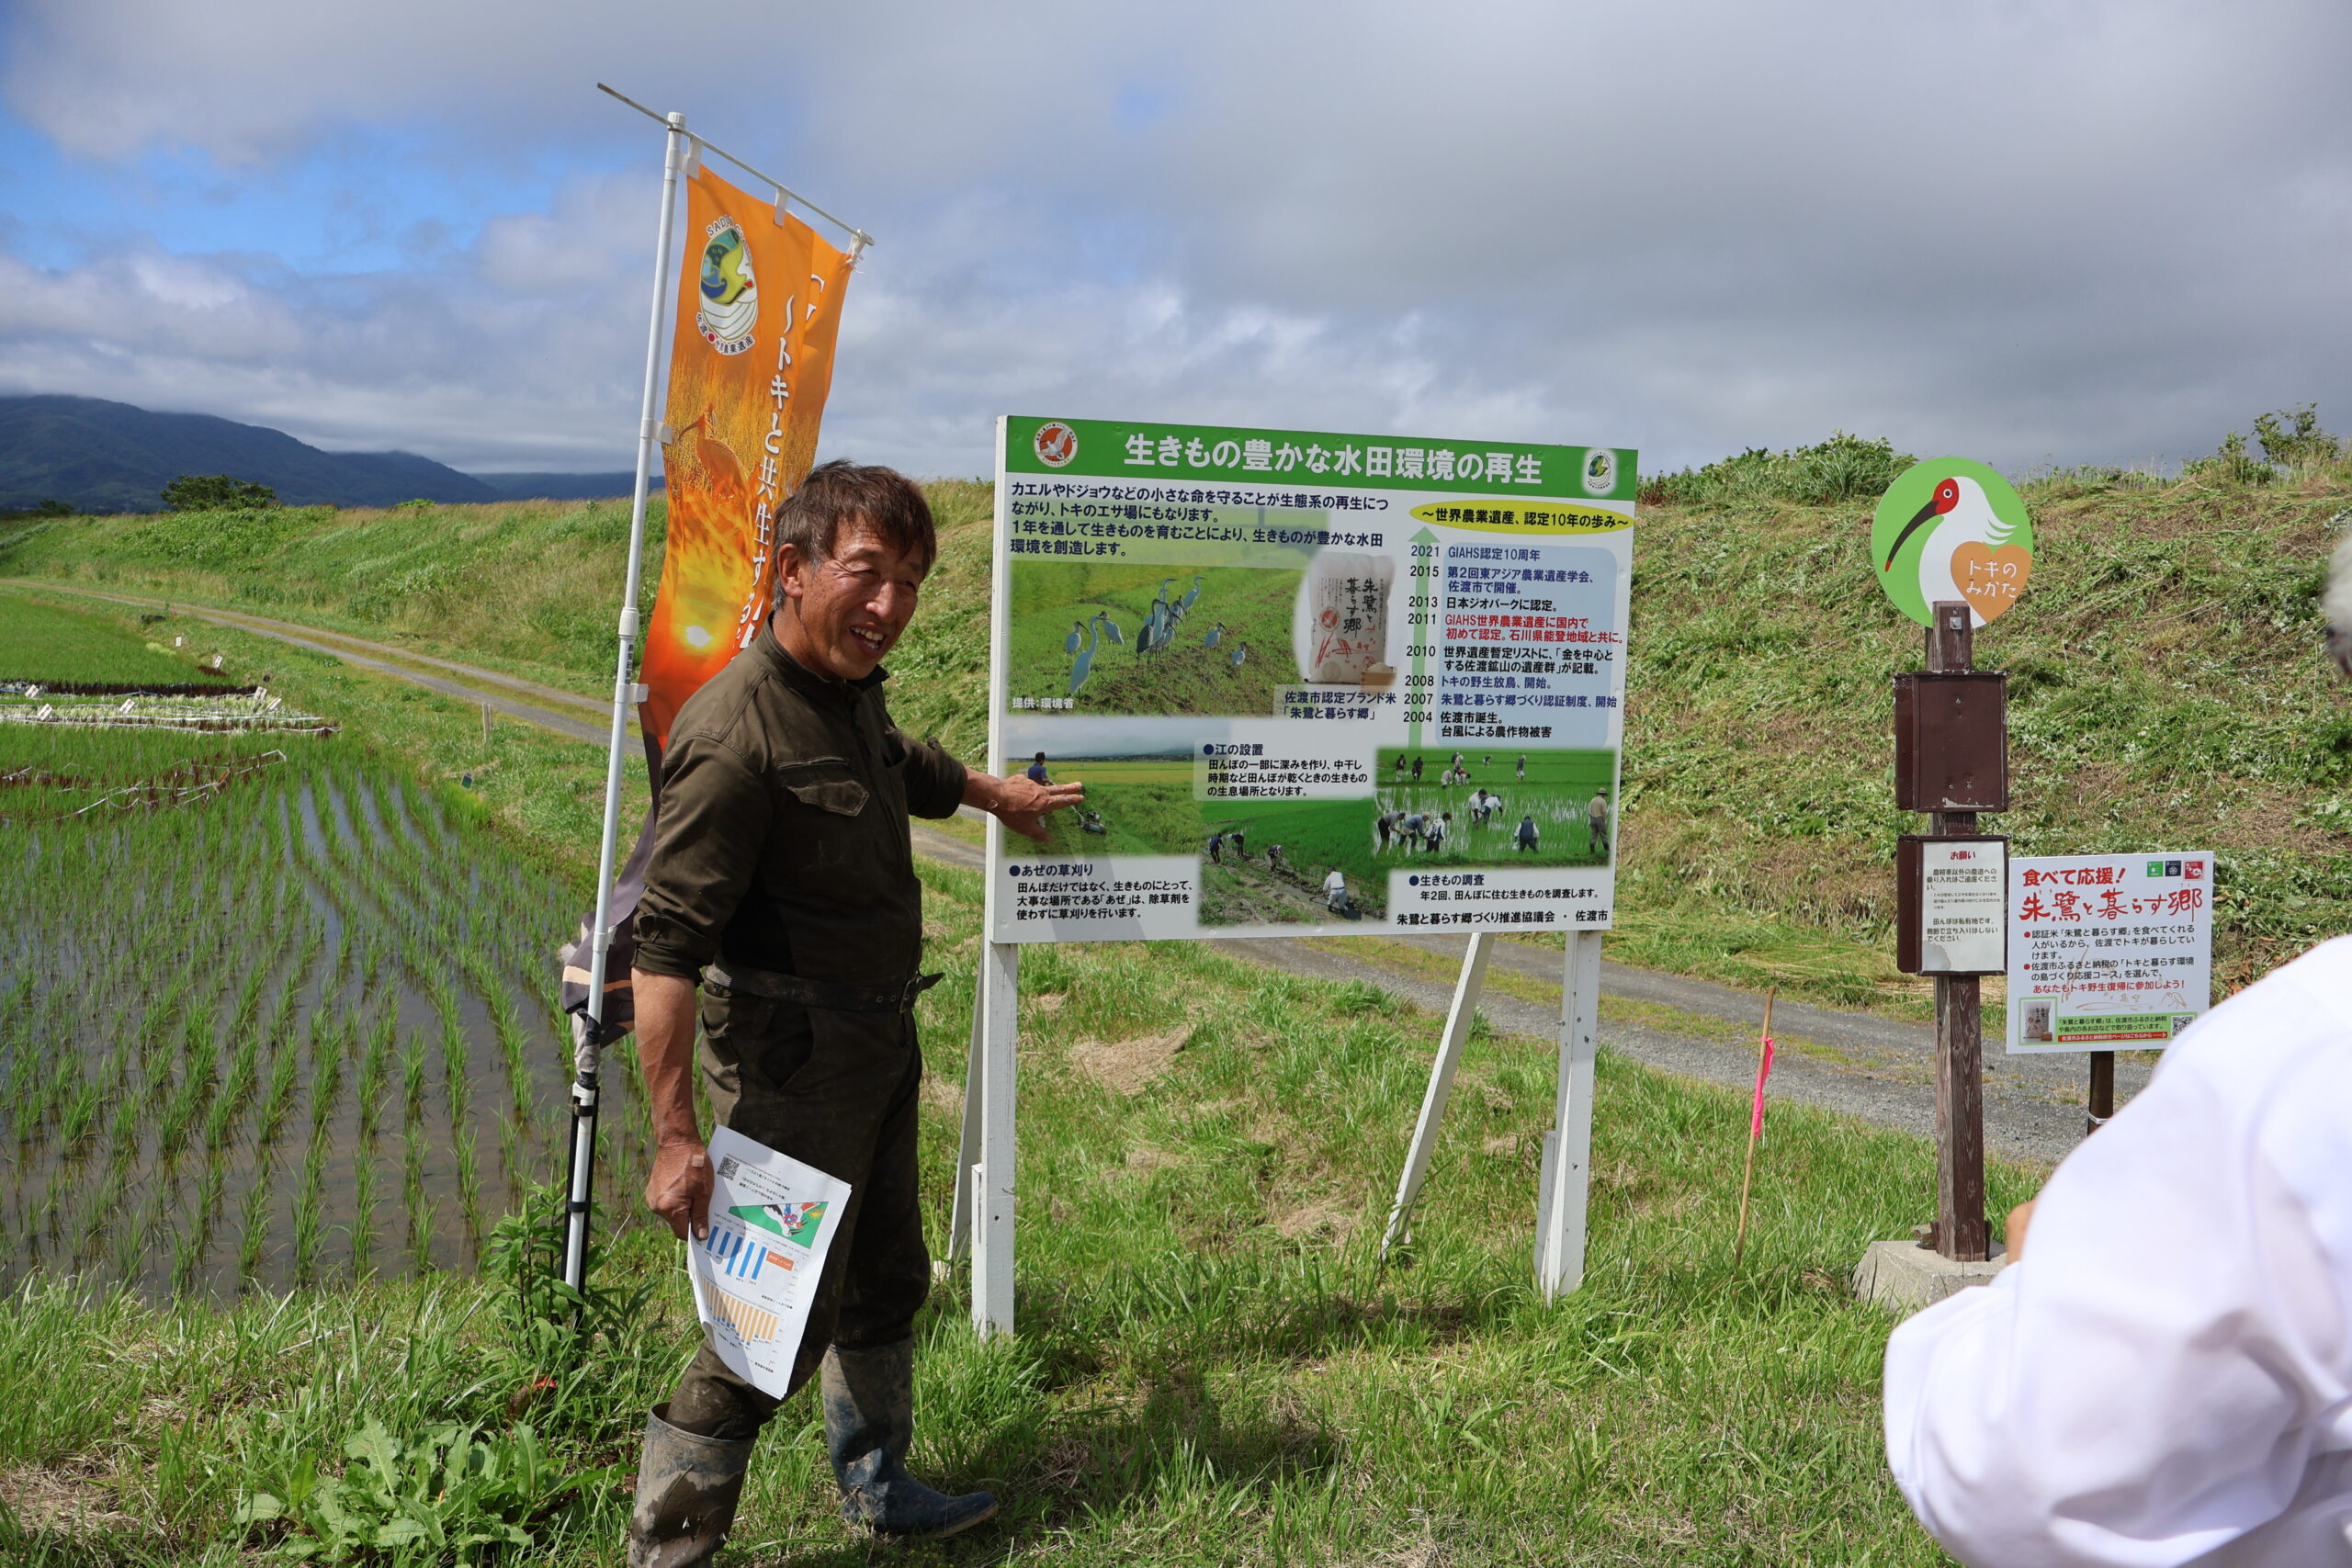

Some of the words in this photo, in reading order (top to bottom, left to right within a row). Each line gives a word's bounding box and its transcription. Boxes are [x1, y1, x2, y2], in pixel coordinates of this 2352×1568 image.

[1124, 433, 1543, 485] 生きもの豊かな水田環境の再生
[1012, 482, 1389, 511] カエルやドジョウなどの小さな命を守ることが生態系の再生につ
[1012, 502, 1219, 523] ながり、トキのエサ場にもなります。
[1012, 520, 1384, 547] 1年を通して生きものを育むことにより、生きものが豊かな水田
[1010, 538, 1126, 558] 環境を創造します。
[1410, 545, 1440, 558] 2021
[1447, 547, 1541, 562] GIAHS認定10周年
[1409, 565, 1439, 578] 2015
[1447, 566, 1594, 583] 第2回東アジア農業遺産学会、
[1969, 559, 2017, 579] トキの
[1448, 581, 1521, 594] 佐渡市で開催。
[1966, 580, 2017, 598] みかた
[1408, 596, 1438, 608] 2013
[1446, 597, 1557, 612] 日本ジオパークに認定。
[1408, 613, 1436, 625] 2011
[1444, 614, 1589, 630] GIAHS世界農業遺産に国内で
[1445, 627, 1624, 644] 初めて認定。石川県能登地域と共に。
[1406, 645, 1436, 658] 2010
[1443, 646, 1613, 661] 世界遺産暫定リストに、「金を中心と
[1405, 675, 1434, 687] 2008
[1441, 675, 1552, 689] トキの野生放鳥、開始。
[1284, 691, 1396, 705] 佐渡市認定ブランド米
[1404, 694, 1433, 705] 2007
[1441, 694, 1618, 708] 朱鷺と暮らす郷づくり認証制度、開始
[1283, 706, 1375, 720] 「朱鷺と暮らす郷」
[1403, 711, 1432, 723] 2004
[1440, 711, 1503, 724] 佐渡市誕生。
[1441, 725, 1552, 739] 台風による農作物被害
[1208, 759, 1363, 771] 田んぼの一部に深みを作り、中干し
[1207, 773, 1368, 784] 時期など田んぼが乾くときの生きもの
[1207, 785, 1307, 797] の生息場所となります。
[1950, 851, 1976, 861] お願い
[1017, 880, 1193, 894] 田んぼだけではなく、生きものにとって、
[1017, 893, 1190, 907] 大事な場所である「あぜ」は、除草剤を
[1419, 888, 1600, 901] 年2回、田んぼに住む生きものを調査します。
[2018, 887, 2203, 922] 朱鷺と暮らす郷
[1016, 908, 1142, 920] 使わずに草刈りを行います。
[1396, 910, 1555, 926] 朱鷺と暮らす郷づくり推進協議会
[1575, 909, 1609, 922] 佐渡市
[2031, 925, 2195, 938] 認証米「朱鷺と暮らす郷」を食べてくれる
[2031, 936, 2195, 950] 人がいるから、佐渡でトキが暮らしてい
[2031, 951, 2064, 960] けます。
[2030, 956, 2195, 972] 佐渡市ふるさと納税の「トキと暮らす環境
[2030, 969, 2163, 982] の島づくり応援コース」を選んで、
